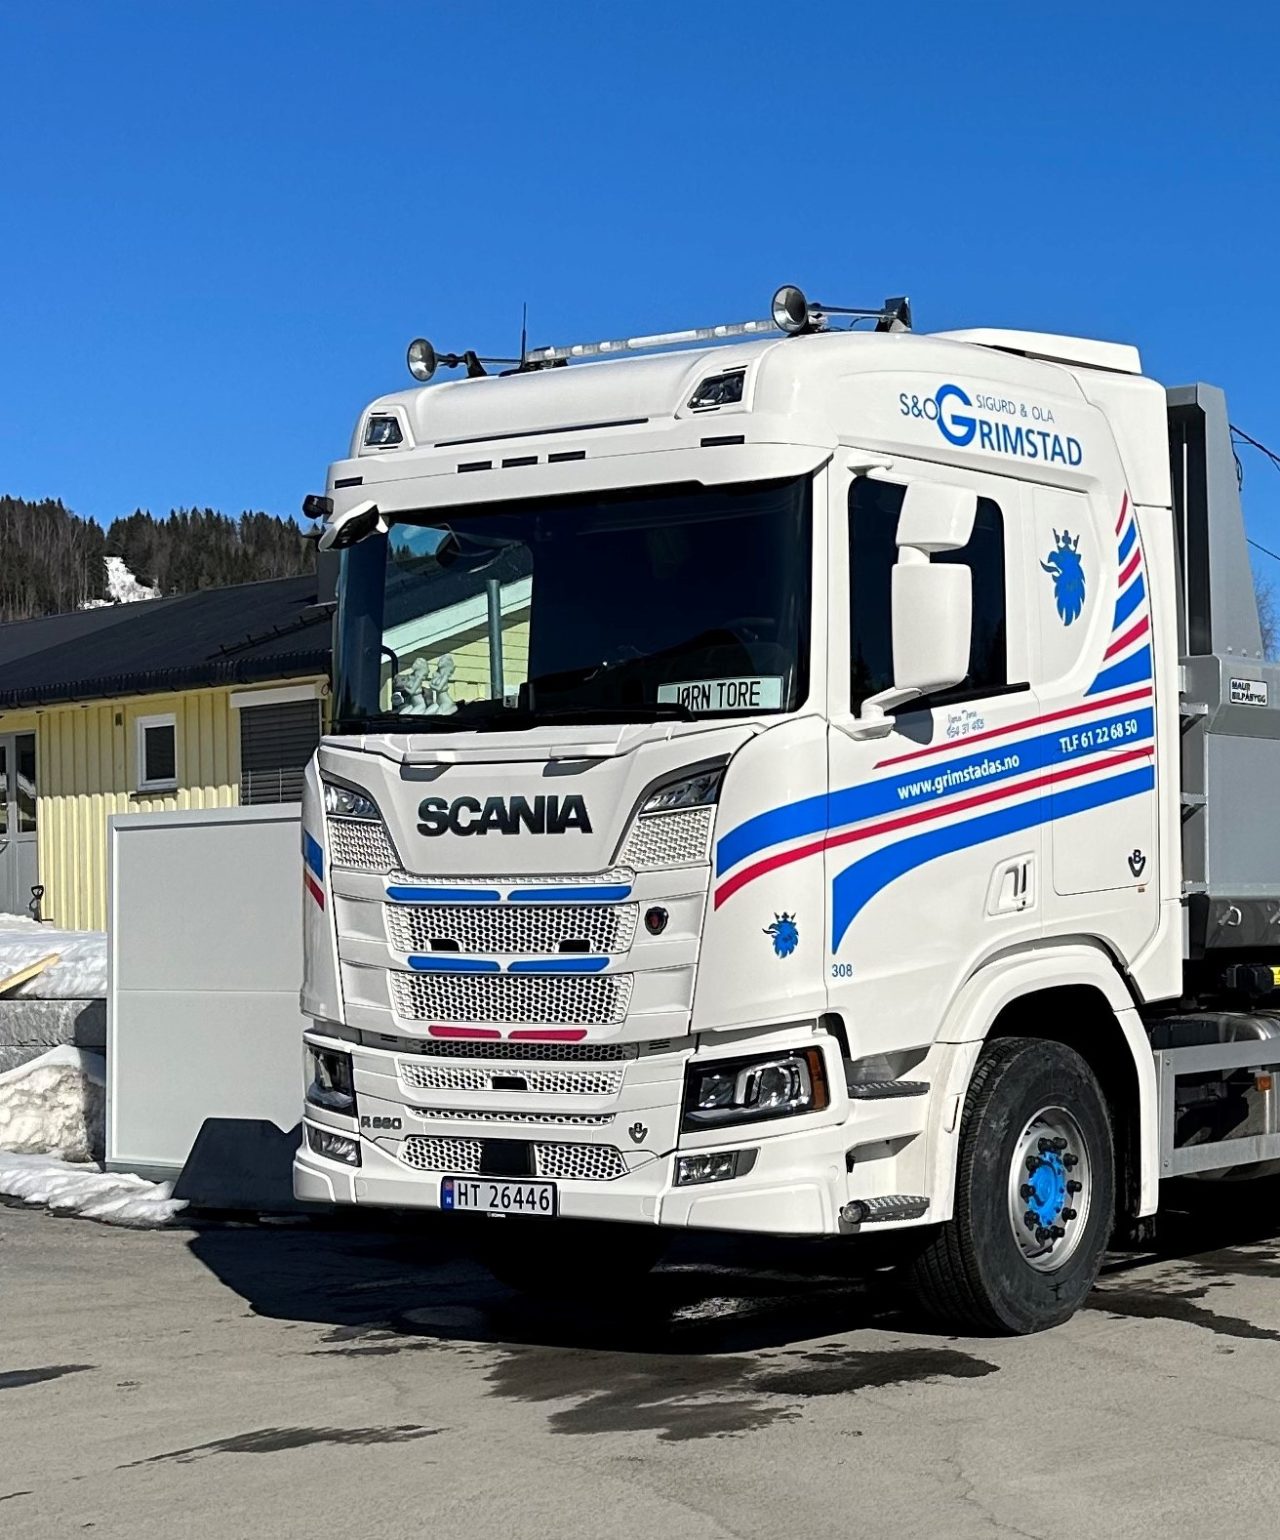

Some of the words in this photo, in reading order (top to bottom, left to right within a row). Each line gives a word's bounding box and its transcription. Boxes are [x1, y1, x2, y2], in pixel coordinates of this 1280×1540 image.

[935, 383, 1083, 467] GRIMSTAD
[975, 394, 1017, 416] SIGURD
[1020, 403, 1028, 418] &
[1031, 406, 1056, 424] OLA
[717, 681, 761, 708] TORE
[1059, 733, 1080, 753] TLF
[1080, 731, 1094, 748] 61
[1095, 726, 1110, 744] 22
[1110, 722, 1124, 740] 68
[1124, 718, 1138, 736] 50
[896, 754, 1021, 801] www.grimstadas.no
[416, 794, 594, 838] SCANIA
[831, 963, 853, 978] 308
[457, 1182, 481, 1207] HT
[488, 1184, 551, 1211] 26446
